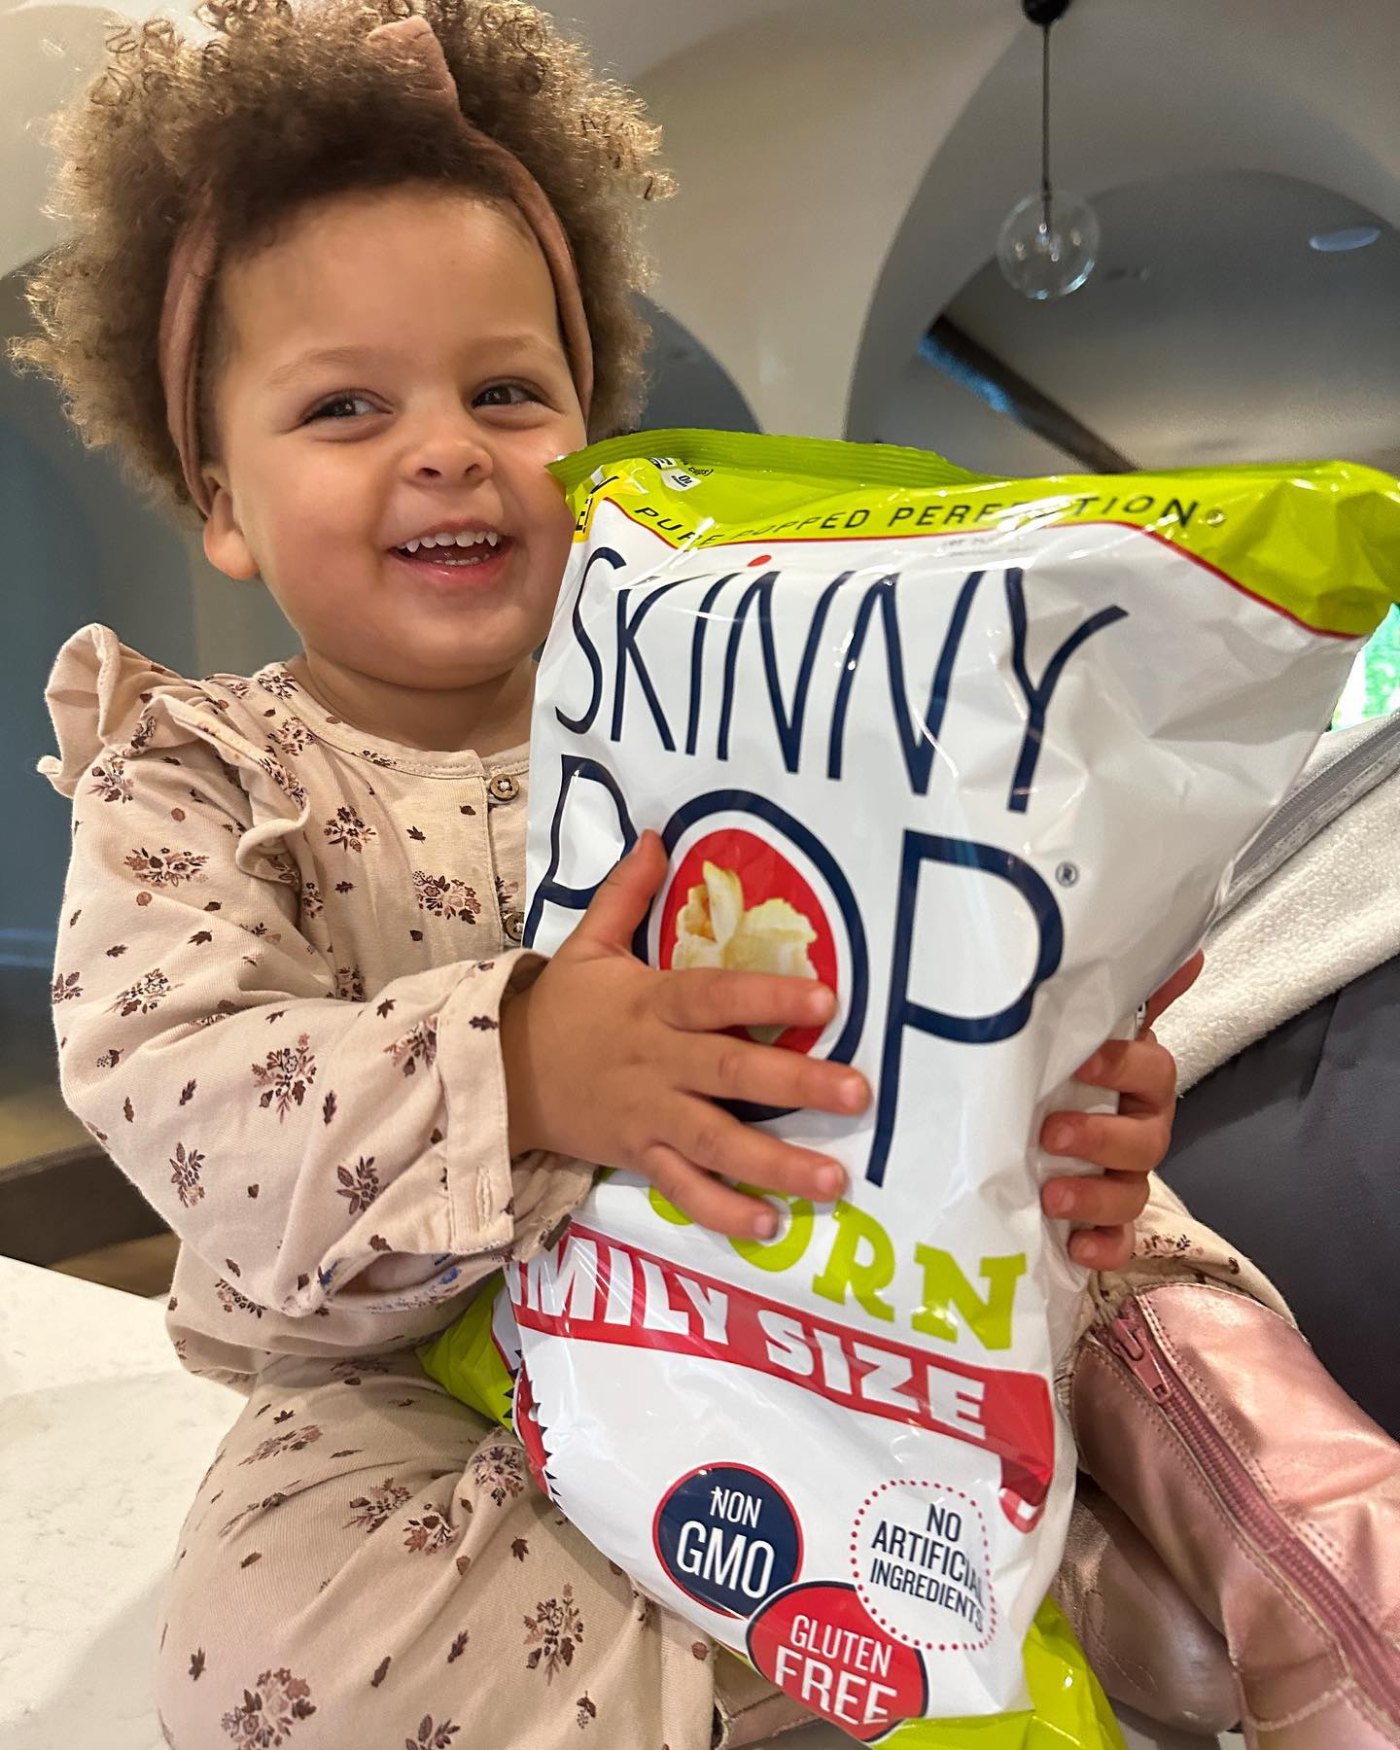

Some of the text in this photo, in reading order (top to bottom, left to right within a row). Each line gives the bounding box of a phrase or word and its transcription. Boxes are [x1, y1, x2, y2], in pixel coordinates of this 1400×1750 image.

[732, 509, 871, 540] POPPED
[555, 546, 1130, 813] SKINNY
[523, 754, 1064, 1188] POP
[649, 1181, 1026, 1351] ORN
[757, 1309, 986, 1440] SIZE
[709, 1486, 762, 1529] NON
[926, 1503, 962, 1543] NO
[676, 1520, 775, 1600] GMO
[870, 1558, 984, 1633] INGREDIENTS
[871, 1520, 986, 1611] ARTIFICIAL
[774, 1645, 898, 1726] FREE
[790, 1615, 893, 1678] GLUTEN
